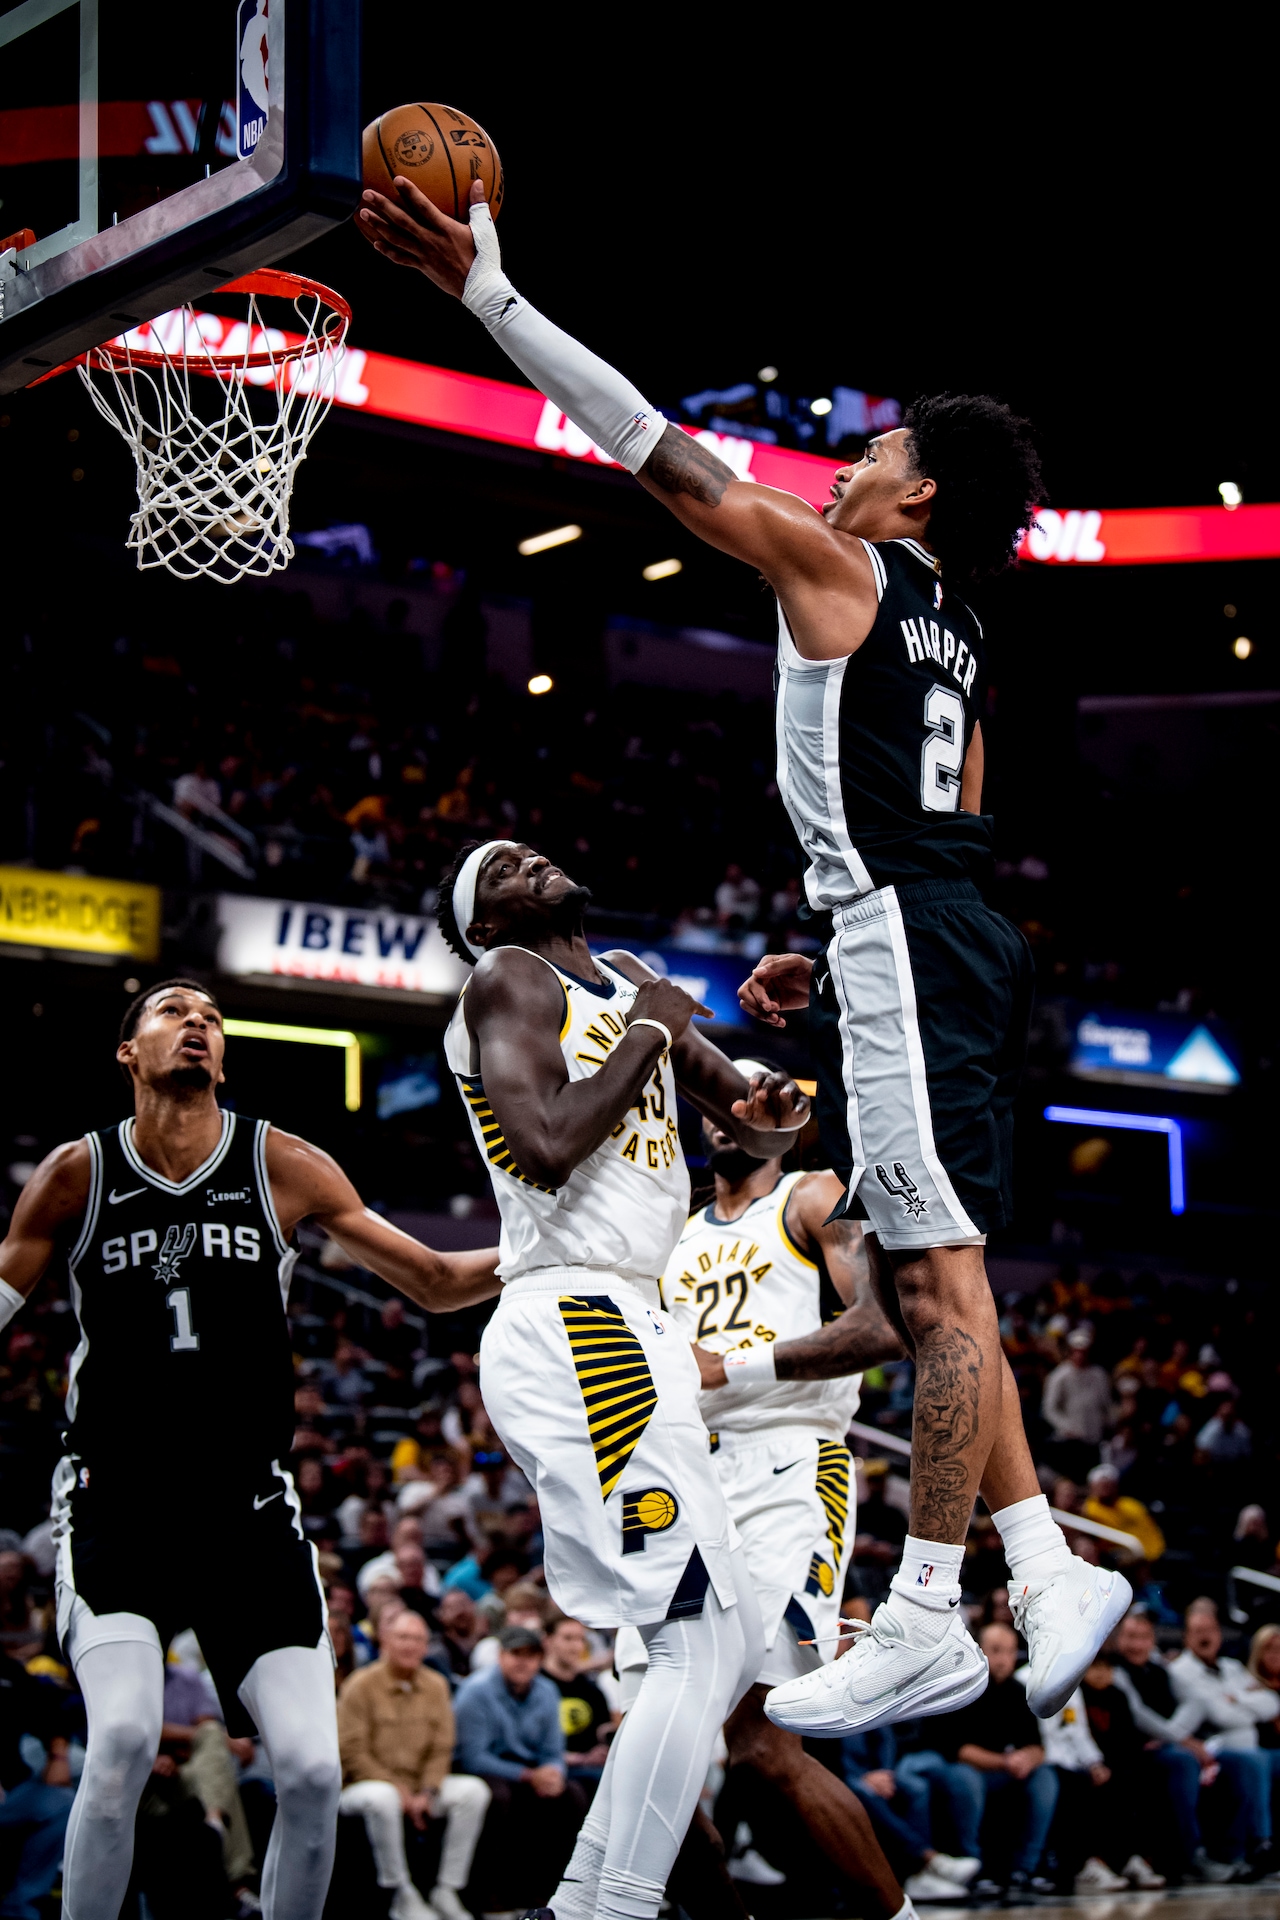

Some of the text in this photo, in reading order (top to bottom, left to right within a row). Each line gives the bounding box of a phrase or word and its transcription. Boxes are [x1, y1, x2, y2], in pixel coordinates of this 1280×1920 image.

[243, 116, 264, 150] NBA
[1028, 508, 1106, 562] OIL
[899, 615, 978, 699] HARPER
[919, 682, 966, 813] 2
[276, 907, 426, 961] IBEW
[212, 1191, 246, 1202] LEDGER
[102, 1223, 261, 1285] SPURS
[674, 1239, 774, 1304] INDIANA
[165, 1286, 201, 1353] 1
[695, 1270, 752, 1343] 22
